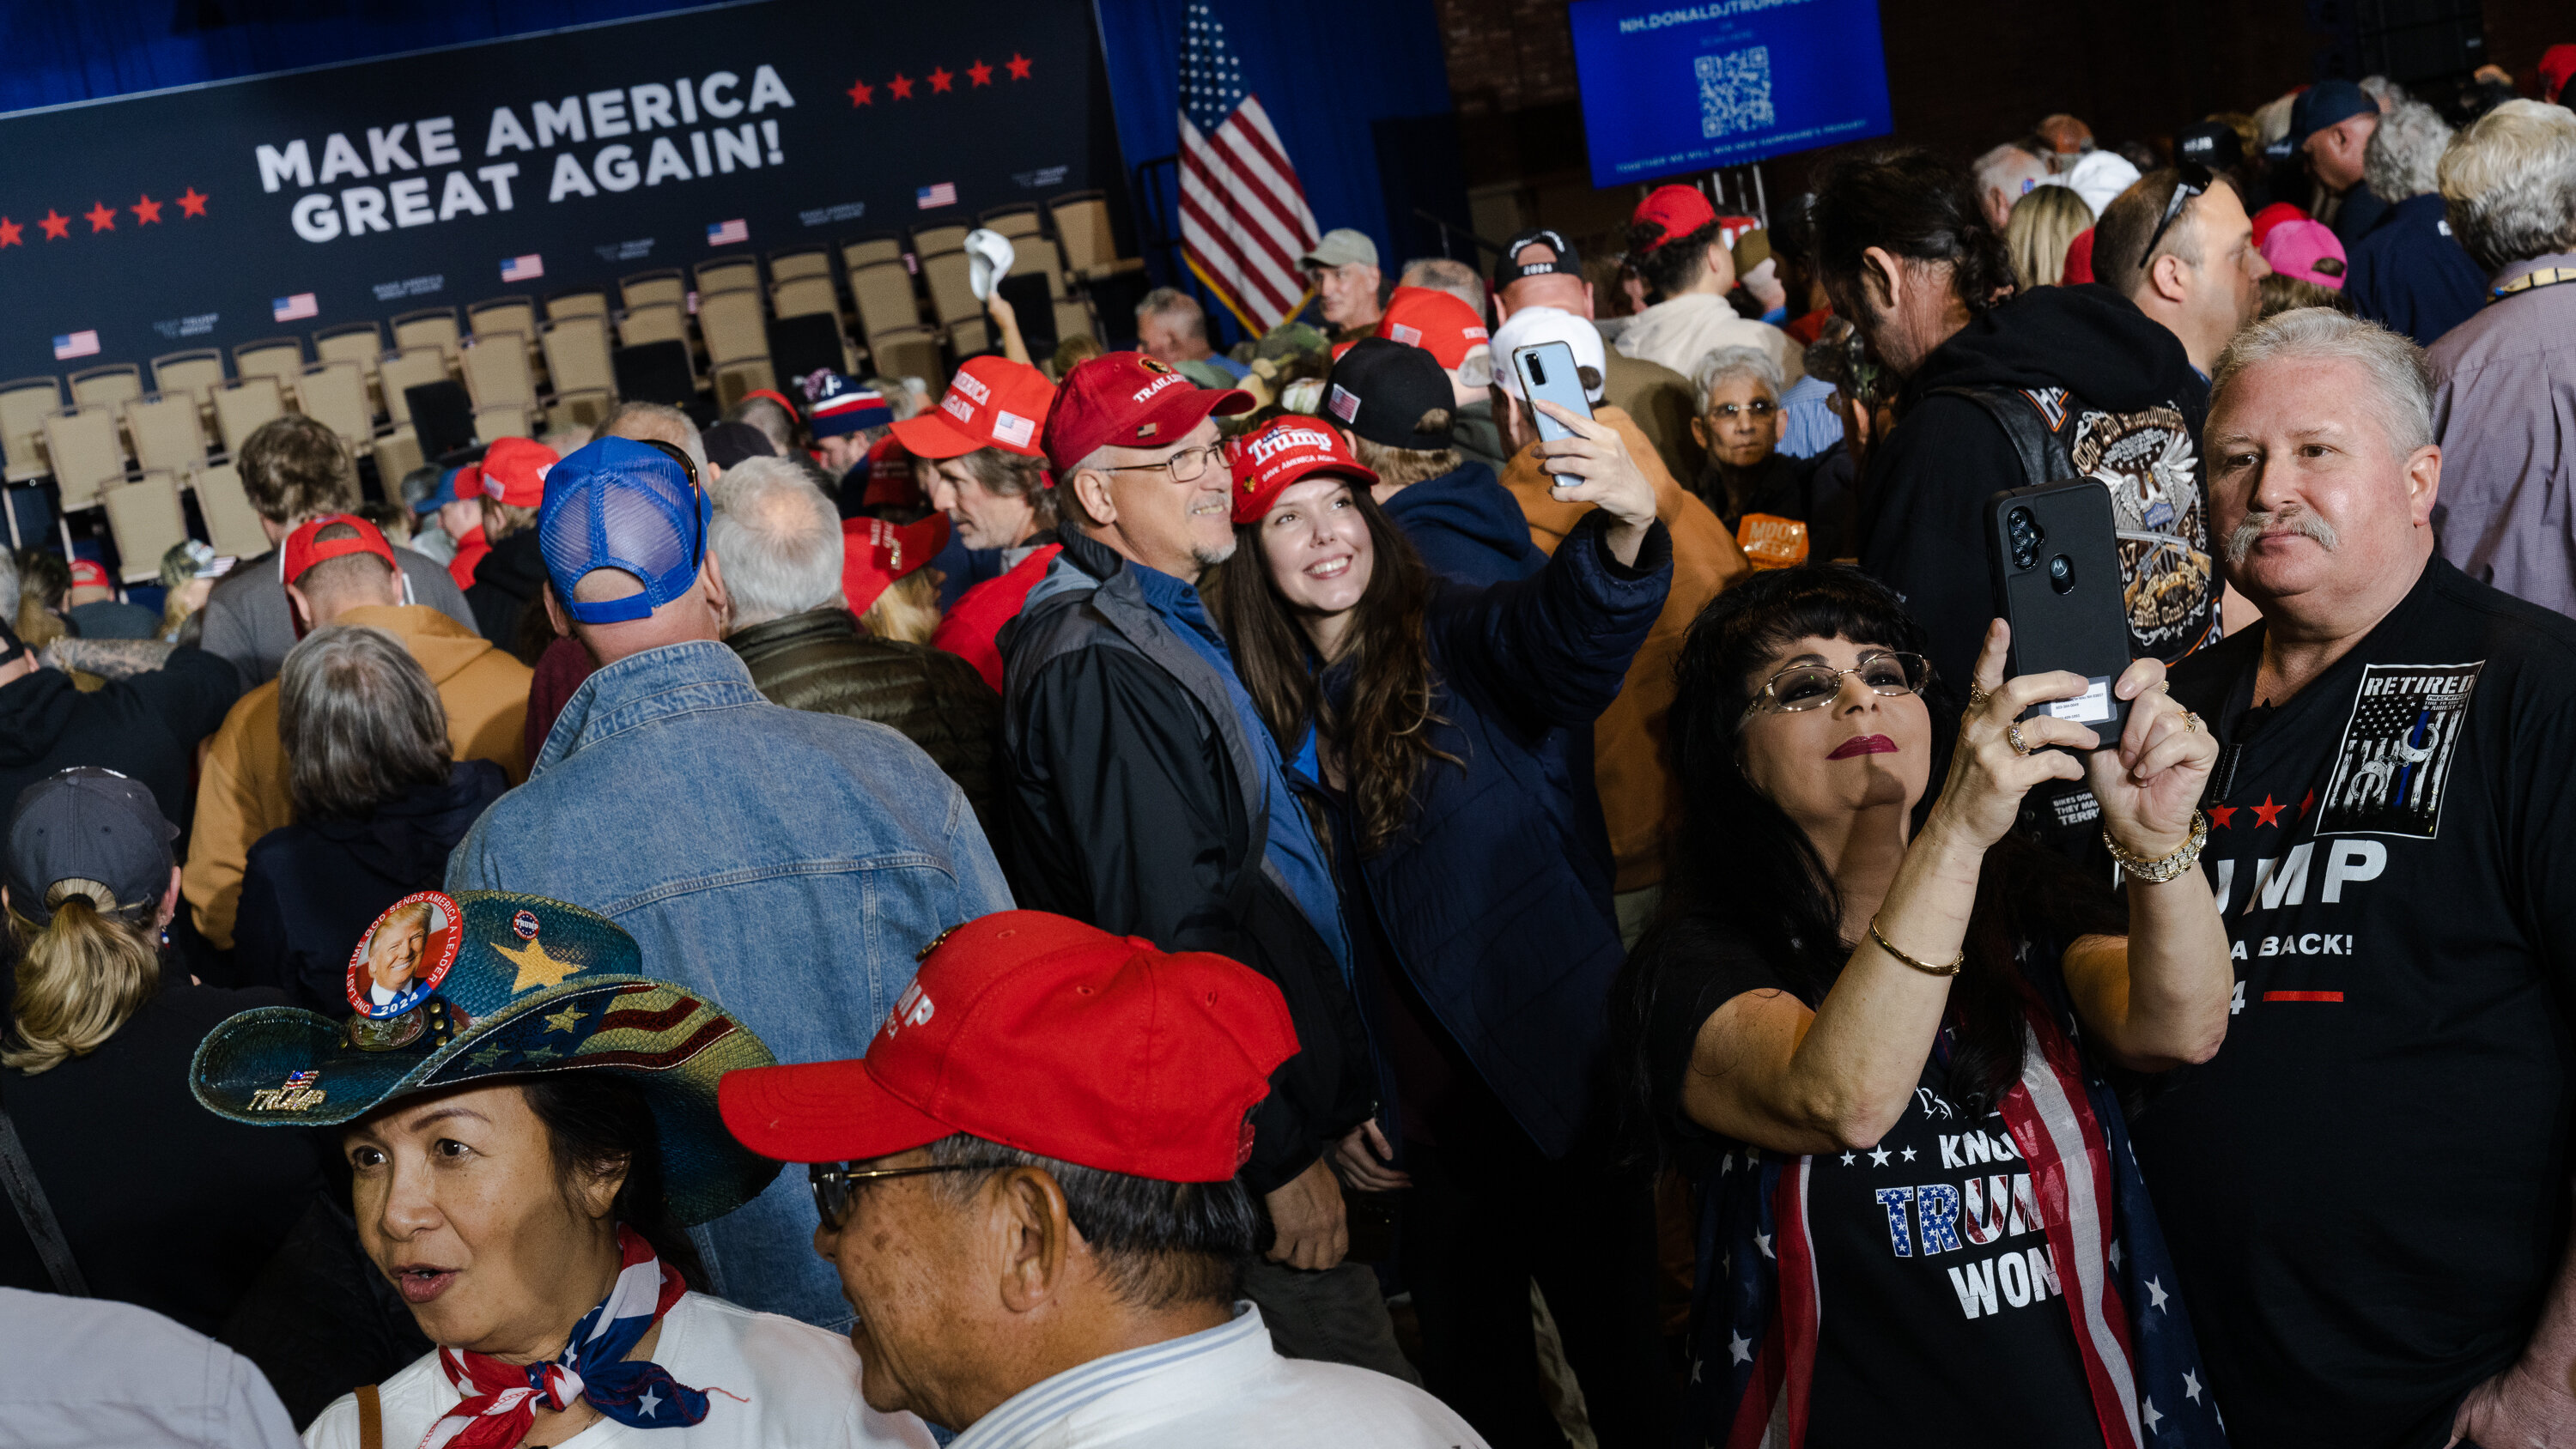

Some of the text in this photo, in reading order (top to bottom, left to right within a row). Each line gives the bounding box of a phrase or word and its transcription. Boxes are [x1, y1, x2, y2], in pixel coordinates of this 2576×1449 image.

[256, 64, 795, 193] MAKE AMERICA
[291, 119, 784, 243] GREAT AGAIN!
[1523, 263, 1552, 276] 2024
[1133, 375, 1170, 403] TRAIL
[1247, 431, 1332, 466] Trump
[2072, 436, 2101, 473] The
[1261, 465, 1281, 482] SAVE
[1281, 454, 1316, 470] AMERICA
[2364, 674, 2475, 696] RETIRED
[2053, 797, 2076, 807] BIKES
[2055, 803, 2079, 815] THEY
[515, 919, 538, 931] TRUMP
[347, 893, 458, 1015] ONE LAST TIME GOD SENDS AMERICA A LEADER
[2258, 933, 2353, 956] BACK!
[381, 992, 419, 1015] 2024
[246, 1089, 326, 1111] TRUMP
[1947, 1244, 2063, 1319] WON
